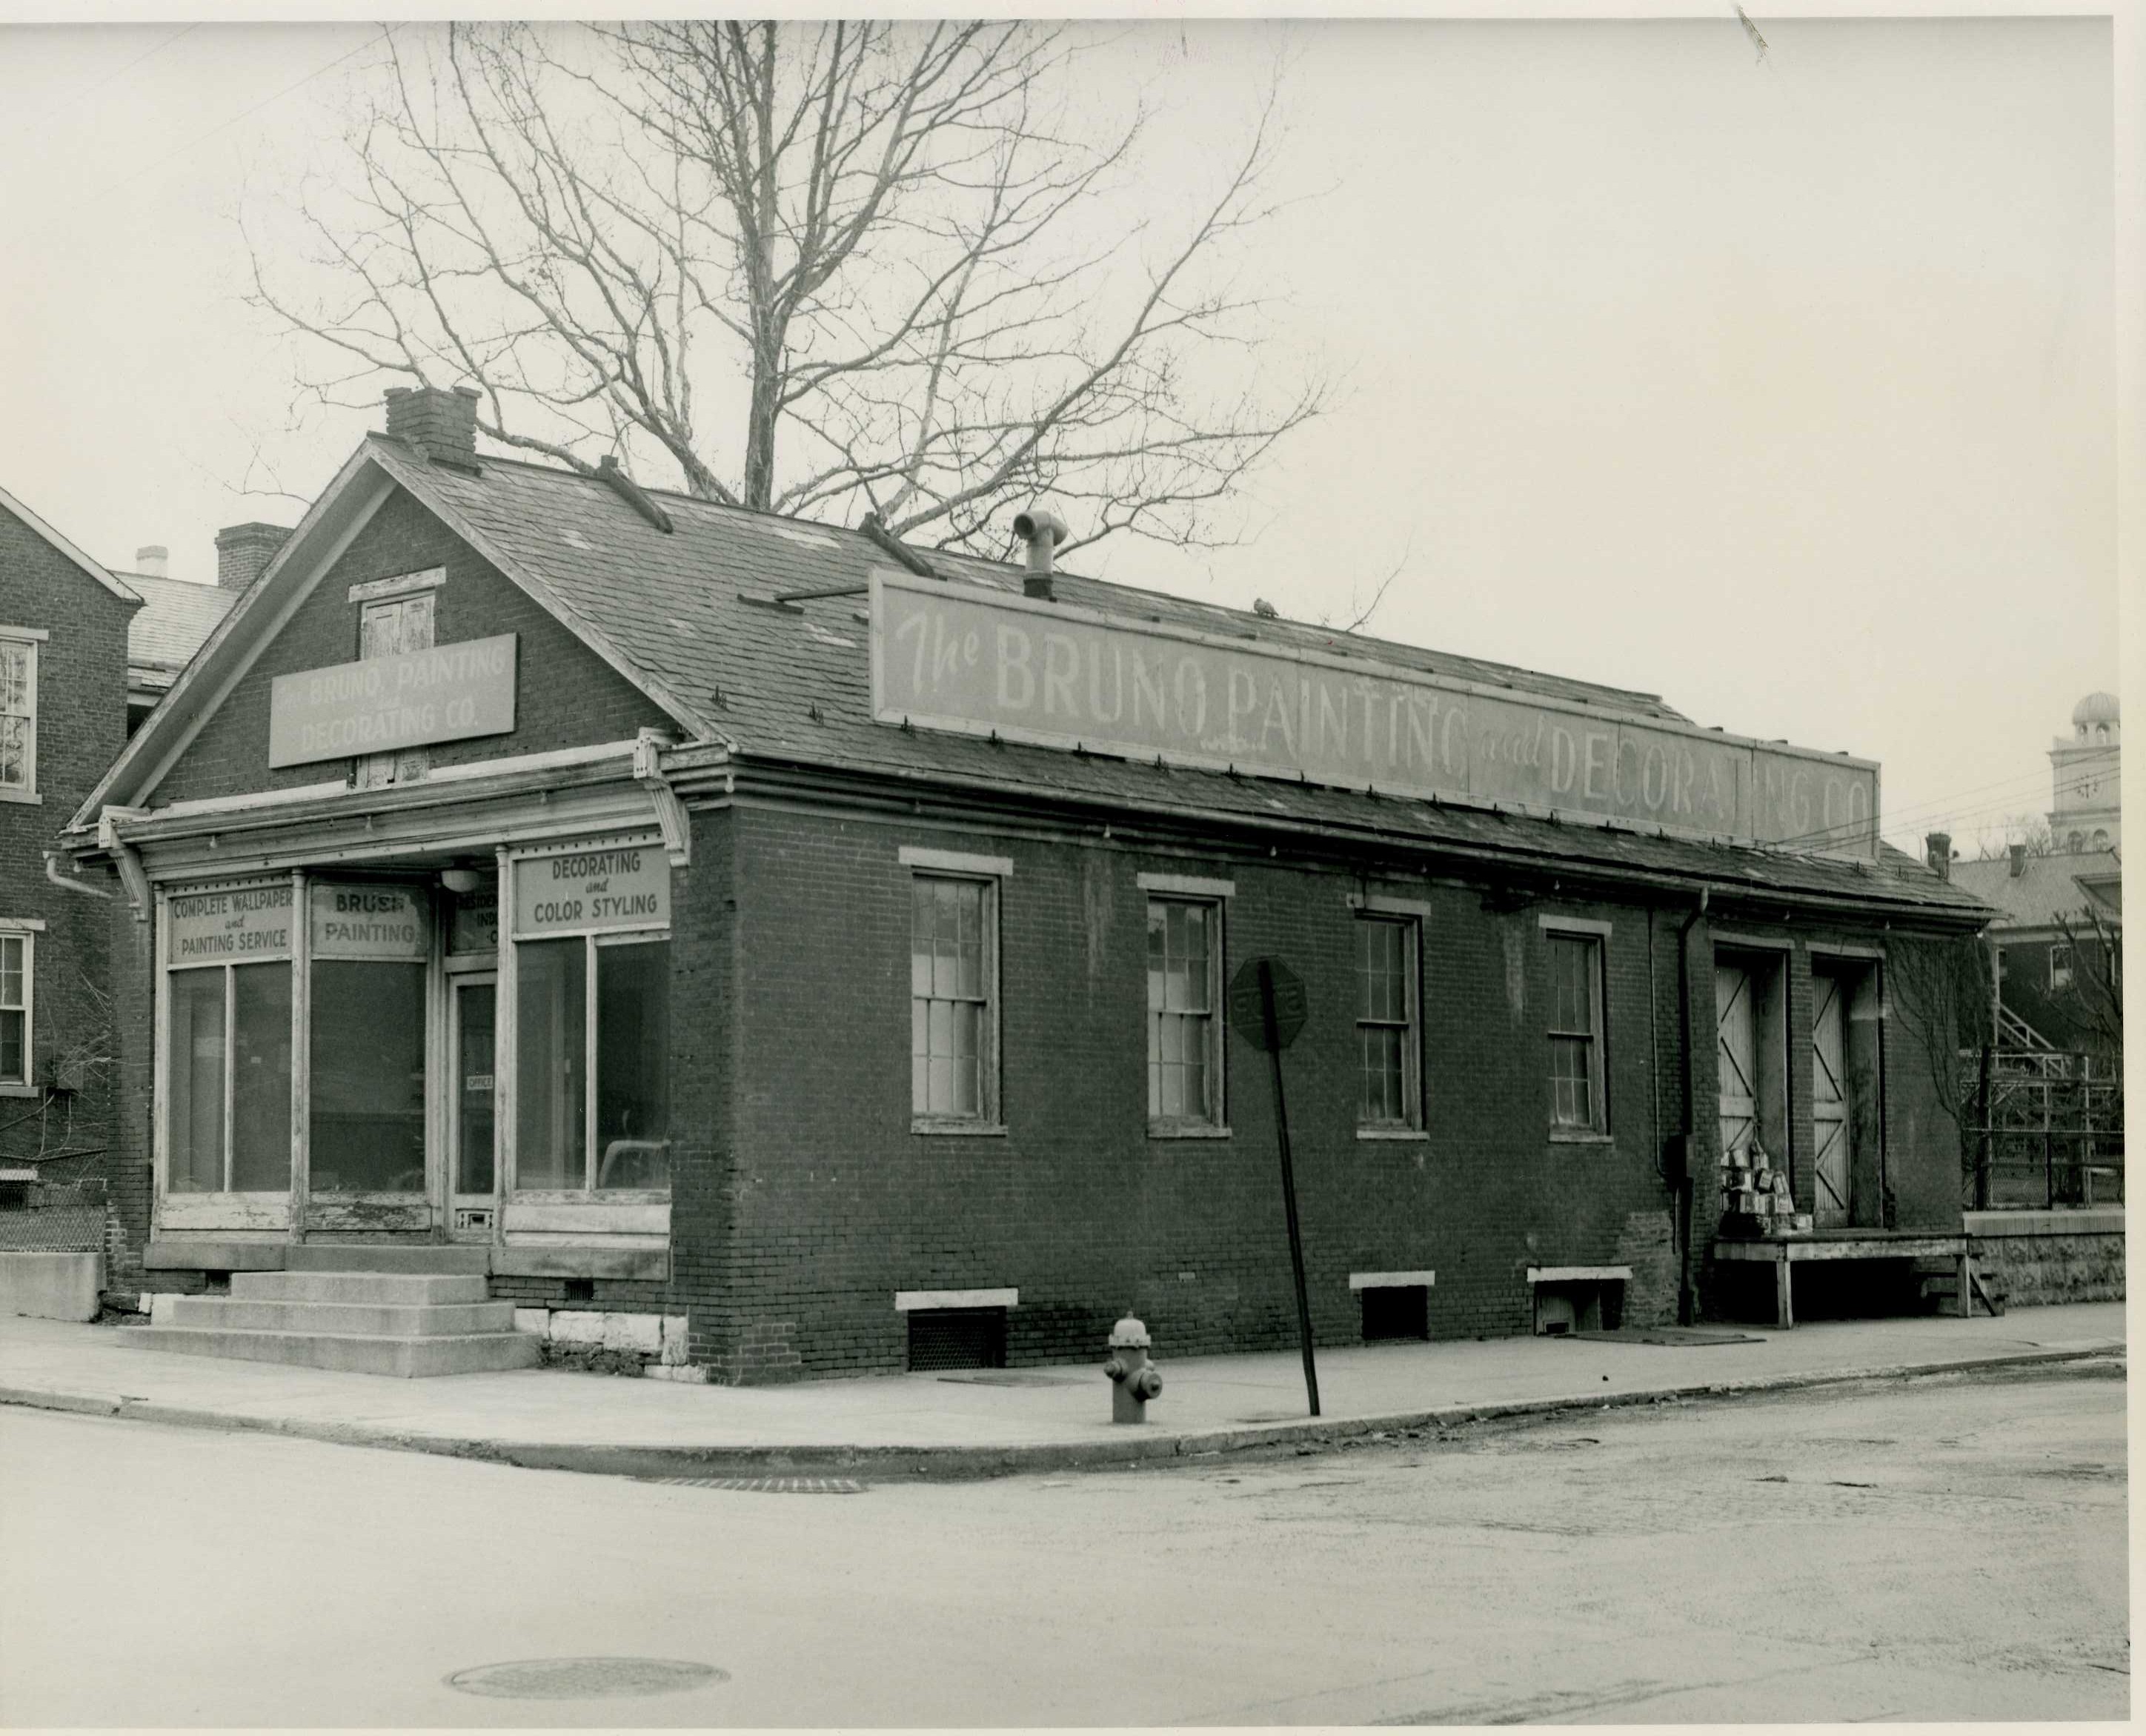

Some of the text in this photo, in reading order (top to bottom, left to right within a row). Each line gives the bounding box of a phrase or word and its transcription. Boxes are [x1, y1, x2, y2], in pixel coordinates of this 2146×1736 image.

[397, 645, 505, 691] PAINTING
[300, 703, 436, 752] DECORATING
[896, 609, 980, 698] The
[996, 623, 1207, 736] BRUNO
[1226, 667, 1468, 782] PAINTING
[1482, 714, 1544, 767] and
[1551, 726, 1810, 833] DECORATING
[553, 853, 641, 879] DECORATING
[585, 878, 609, 894] and
[173, 890, 293, 919] COMPLETE WALLPAPER
[336, 894, 405, 913] BRUSH
[534, 894, 657, 922] COLOR STYLING
[225, 915, 245, 929] and
[325, 922, 416, 944] PAINTING
[182, 929, 288, 955] PAINTING SERVICE
[469, 1077, 492, 1088] OFFICE
